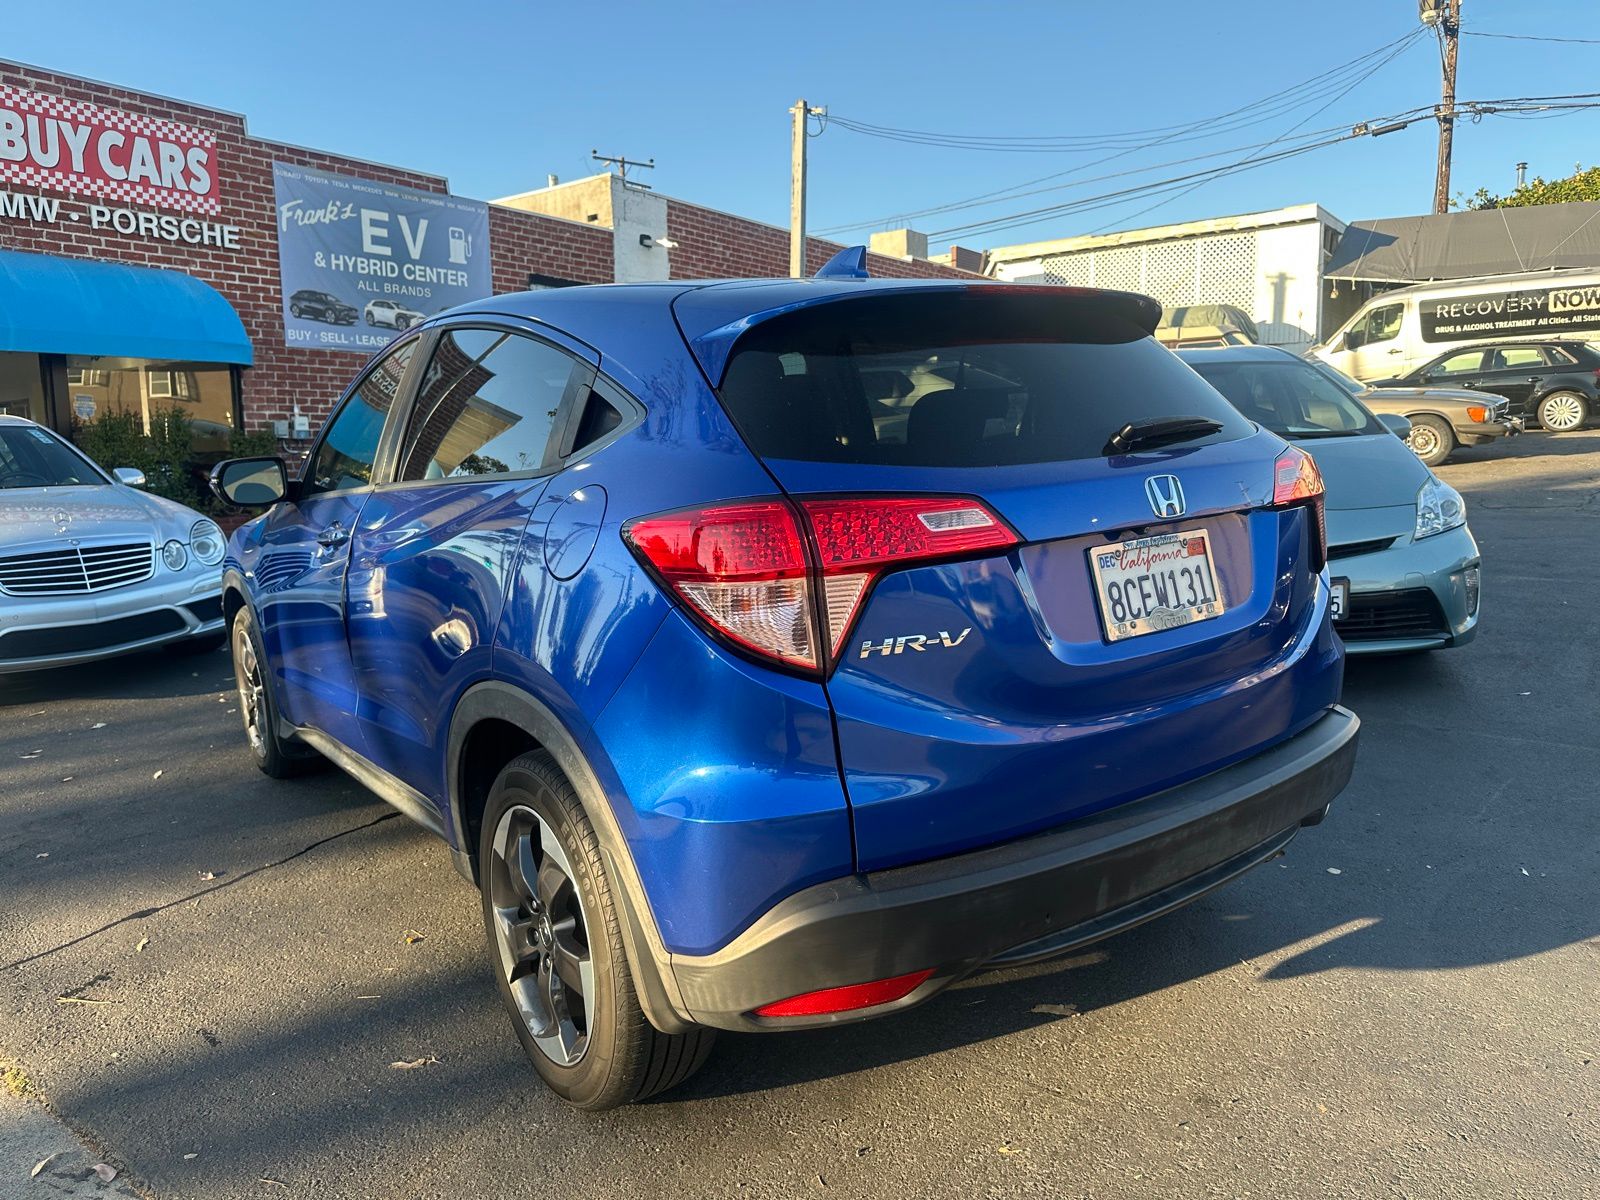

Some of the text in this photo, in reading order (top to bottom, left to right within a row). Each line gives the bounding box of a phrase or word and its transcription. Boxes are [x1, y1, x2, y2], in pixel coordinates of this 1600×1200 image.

[0, 108, 212, 195] BUY CARS
[305, 175, 329, 185] TOYOTA
[332, 180, 349, 189] TESLA
[352, 184, 382, 195] MERCEDES
[90, 204, 241, 250] PORSCHE
[279, 199, 429, 260] Frank's EV
[314, 251, 468, 287] & HYBRID CENTER
[357, 279, 432, 298] ALL BRANDS
[1436, 289, 1600, 318] RECOVERY NOW
[288, 329, 311, 340] BUY
[320, 332, 348, 344] SELL
[1435, 325, 1454, 333] DRUG
[1463, 322, 1494, 331] ALCOHOL
[1495, 319, 1536, 328] TREATMENT
[1572, 315, 1582, 323] All
[1099, 547, 1183, 572] DEC California
[1107, 564, 1211, 623] 8CEW131
[860, 627, 972, 659] HR-V
